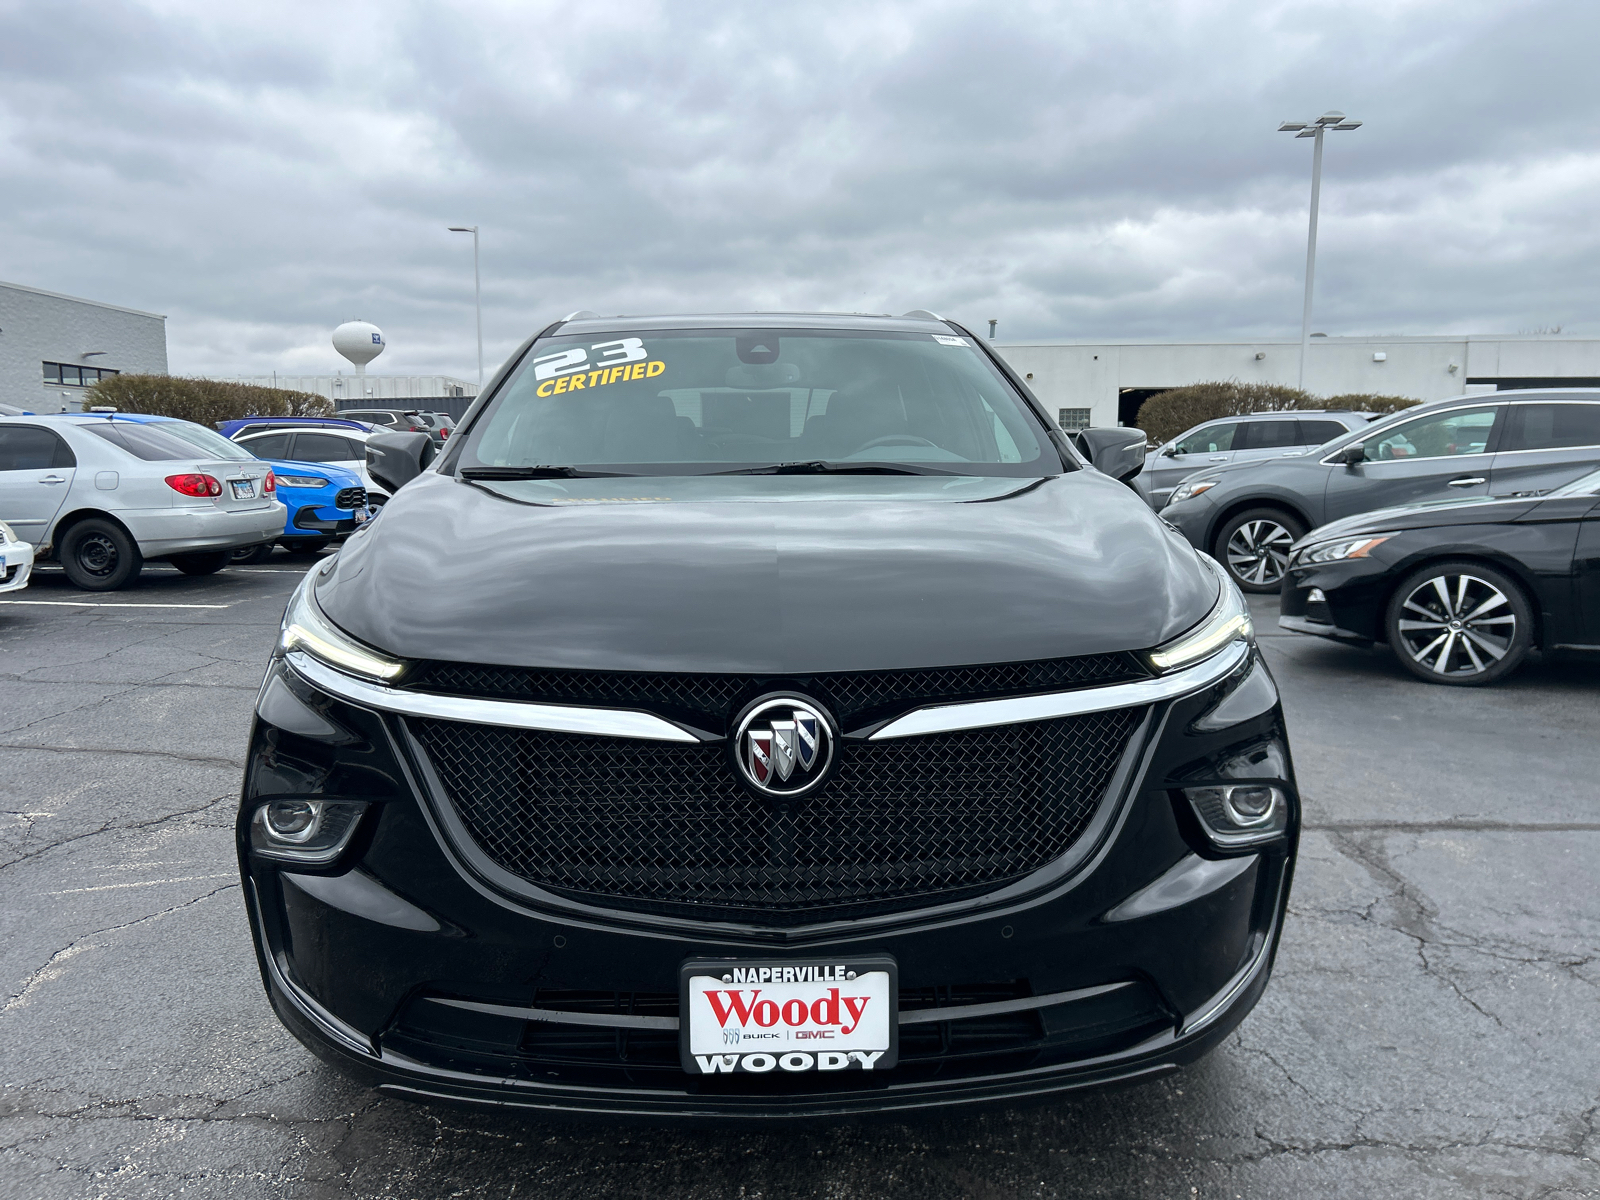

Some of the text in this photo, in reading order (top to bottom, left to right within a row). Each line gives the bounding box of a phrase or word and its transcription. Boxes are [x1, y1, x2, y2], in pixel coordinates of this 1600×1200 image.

[533, 337, 648, 381] 23
[536, 361, 666, 398] CERTIFIED
[733, 966, 846, 983] NAPERVILLE
[703, 988, 871, 1035] Woody
[795, 1030, 835, 1039] GMC
[695, 1051, 885, 1074] WOODY
